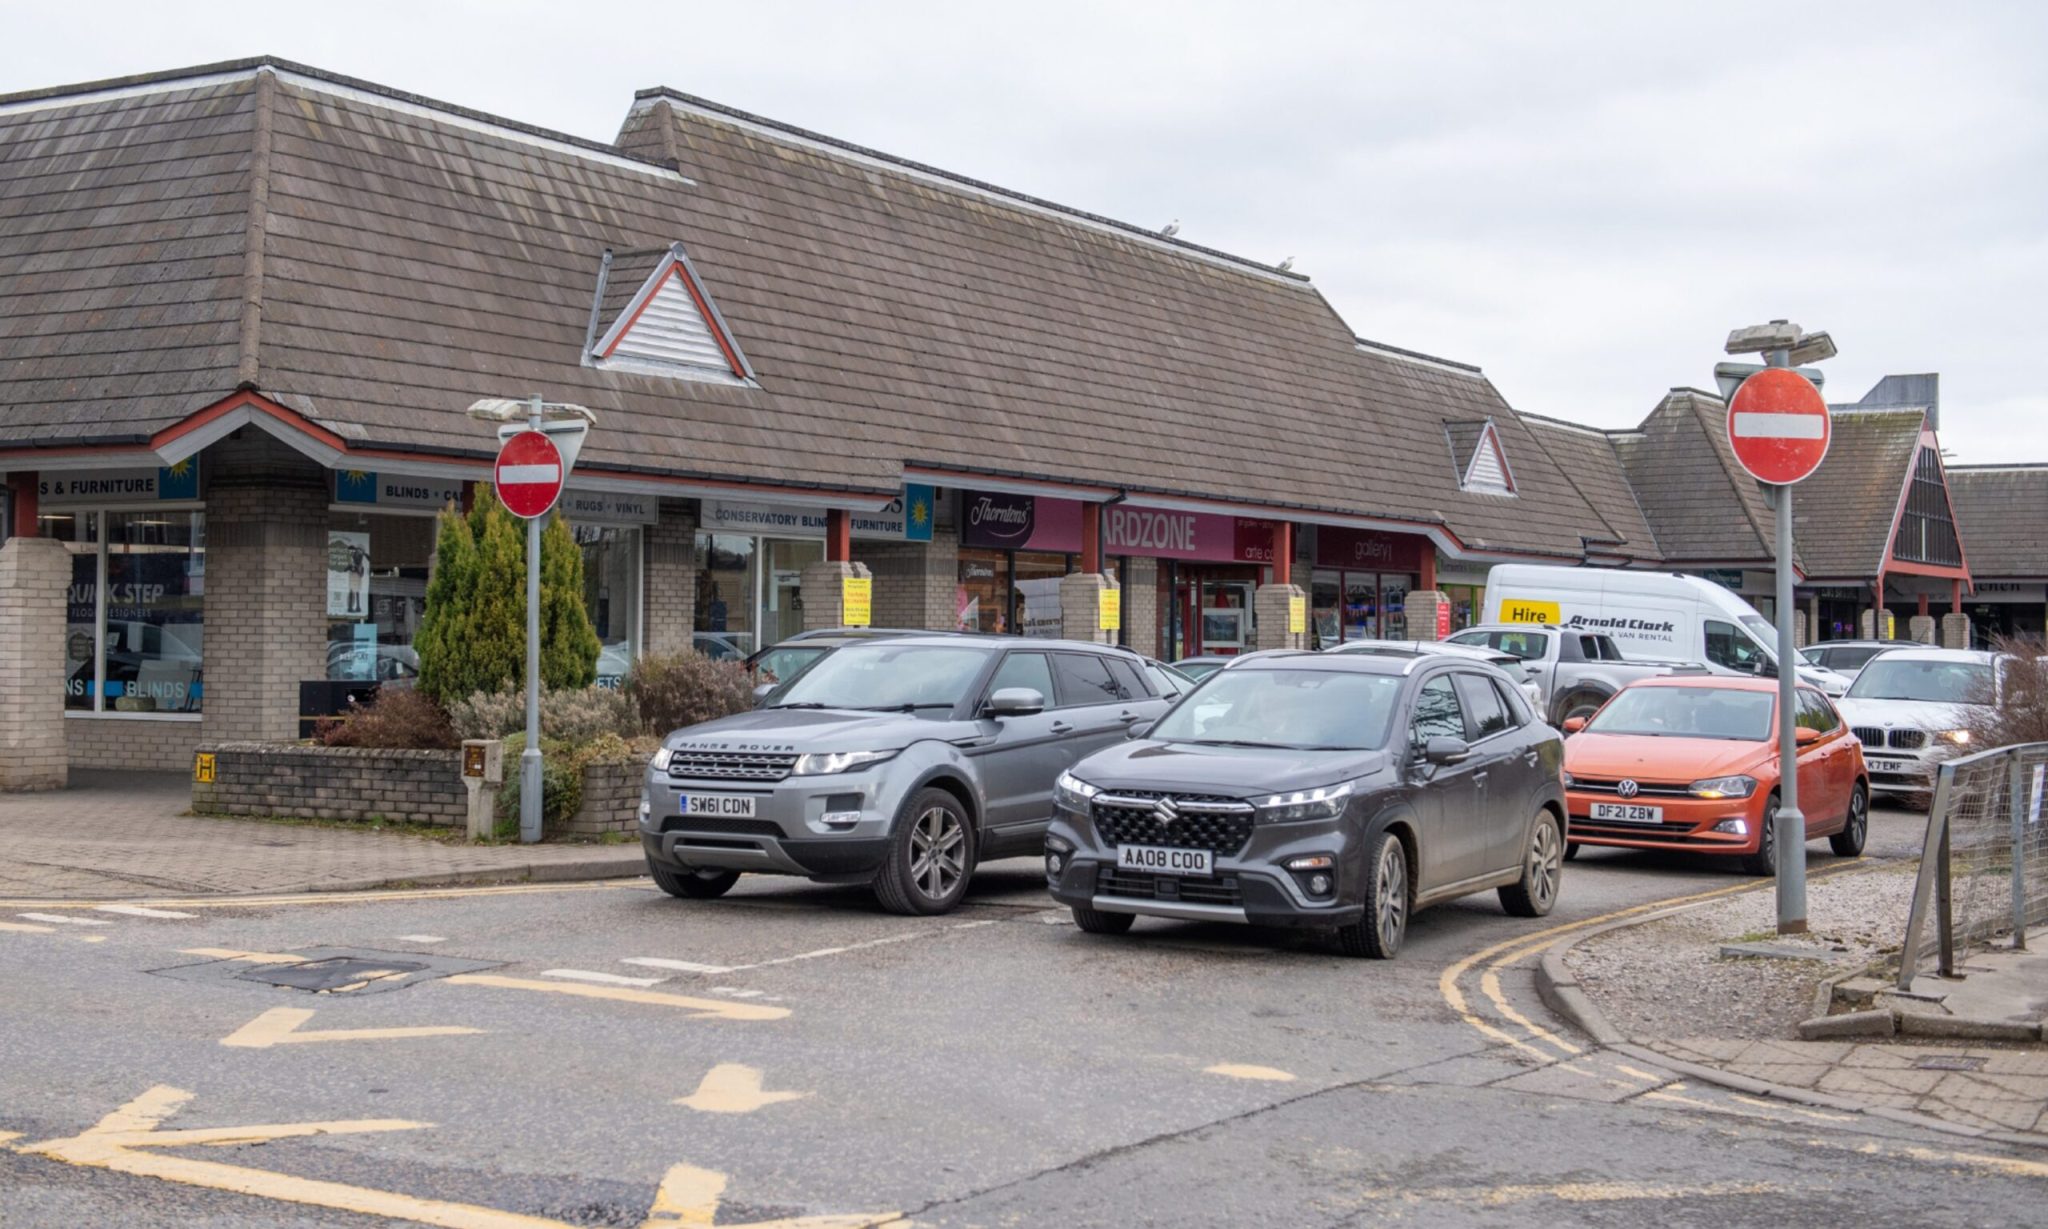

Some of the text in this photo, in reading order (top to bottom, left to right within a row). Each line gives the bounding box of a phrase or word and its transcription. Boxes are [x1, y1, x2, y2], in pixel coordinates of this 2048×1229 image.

[54, 481, 65, 494] &
[71, 478, 155, 494] FURNITURE
[386, 485, 429, 499] BLINDS
[575, 500, 603, 512] RUGS
[615, 502, 645, 514] VINYL
[971, 497, 1027, 526] Thorntons
[715, 508, 798, 526] CONSERVATORY
[851, 518, 903, 533] FURNITURE
[68, 583, 165, 604] QUIK STEP
[71, 608, 152, 618] FLOO ESIGNERS
[1512, 608, 1547, 623] Hire
[1570, 615, 1674, 632] Arnold Clark
[1638, 633, 1673, 643] RENTAL
[126, 681, 185, 698] BLINDS
[594, 676, 622, 689] ETS
[690, 796, 750, 815] SW61 CDN
[1598, 804, 1655, 821] DF21 ZBW
[1125, 848, 1205, 870] AA08 COO
